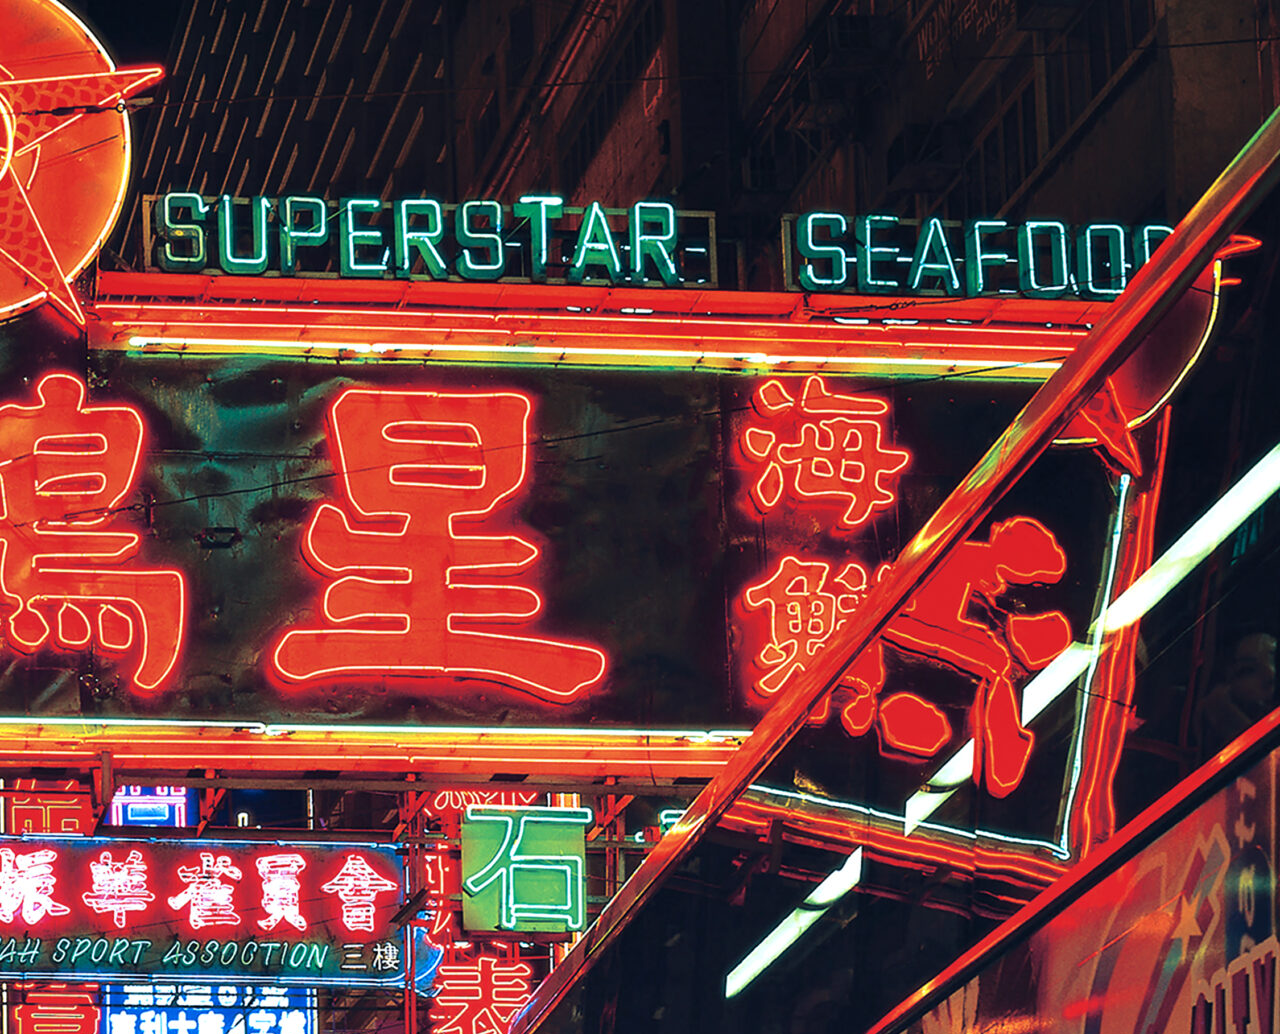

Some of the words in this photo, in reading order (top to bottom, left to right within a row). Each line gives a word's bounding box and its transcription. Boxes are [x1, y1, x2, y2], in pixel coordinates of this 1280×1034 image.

[161, 193, 678, 287] SUPERSTAR
[467, 805, 591, 928] 石
[52, 937, 152, 965] SPORT
[163, 939, 329, 969] ASSOCTION
[340, 944, 400, 972] 三樓
